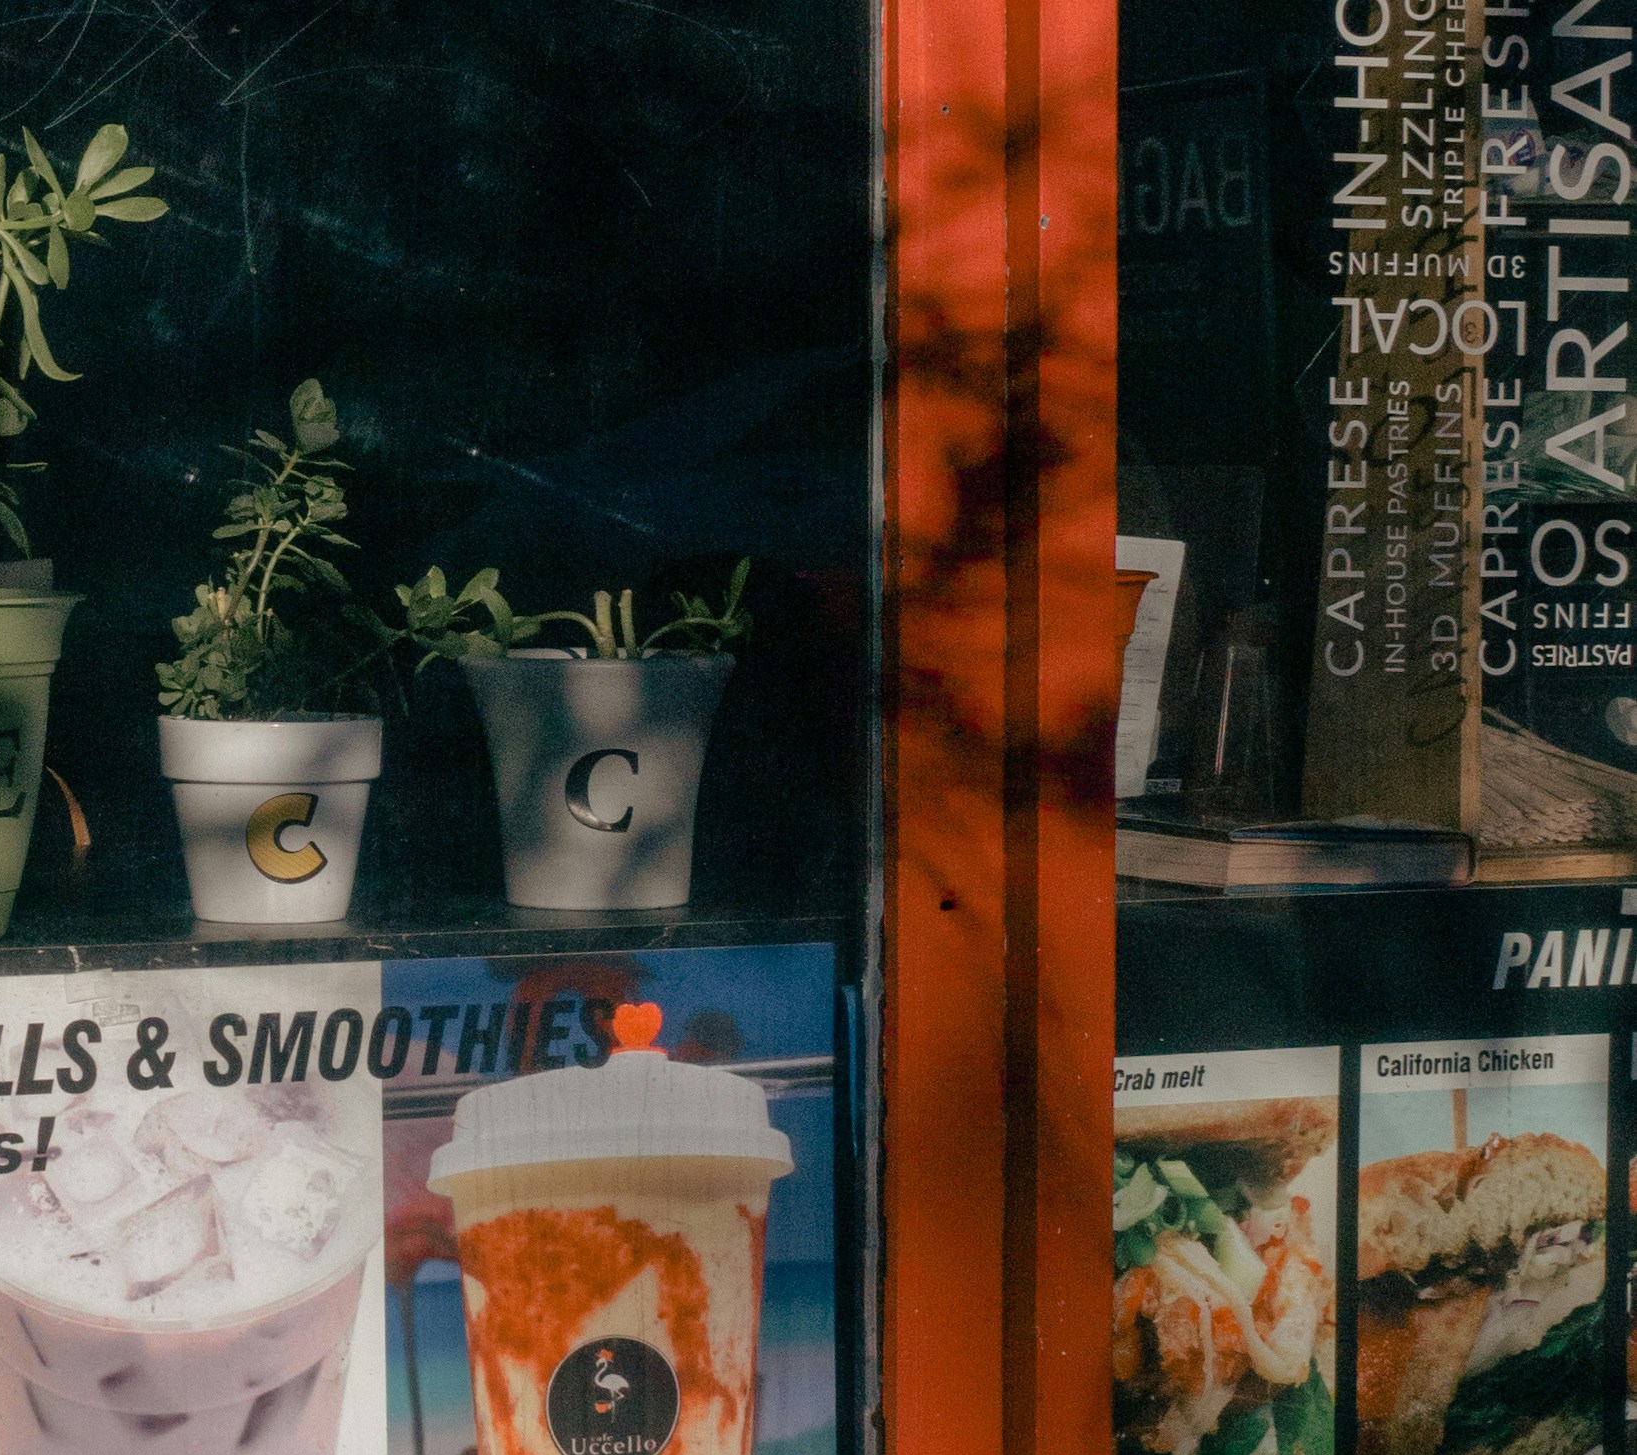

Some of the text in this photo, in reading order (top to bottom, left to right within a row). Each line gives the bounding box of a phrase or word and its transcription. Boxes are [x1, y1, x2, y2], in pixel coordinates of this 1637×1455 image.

[1442, 106, 1466, 230] TRIPLE
[1328, 251, 1527, 279] 3D MUFFINS
[1331, 296, 1527, 356] LOCAL
[1324, 376, 1370, 677] CAPRESE
[1383, 380, 1411, 674] IN-HOUSE PASTRIES
[1428, 383, 1462, 587] MUFFINS
[1478, 377, 1522, 676] CAPRESE
[1431, 614, 1459, 673] 3D
[1531, 643, 1633, 668] PASTRIES
[564, 747, 641, 834] C
[244, 791, 330, 884] C
[1491, 927, 1637, 990] PANI
[126, 1016, 176, 1092] &
[202, 996, 614, 1088] SMOOTHIES
[1112, 1064, 1206, 1093] Crab melt
[1377, 1048, 1554, 1078] California Chicken
